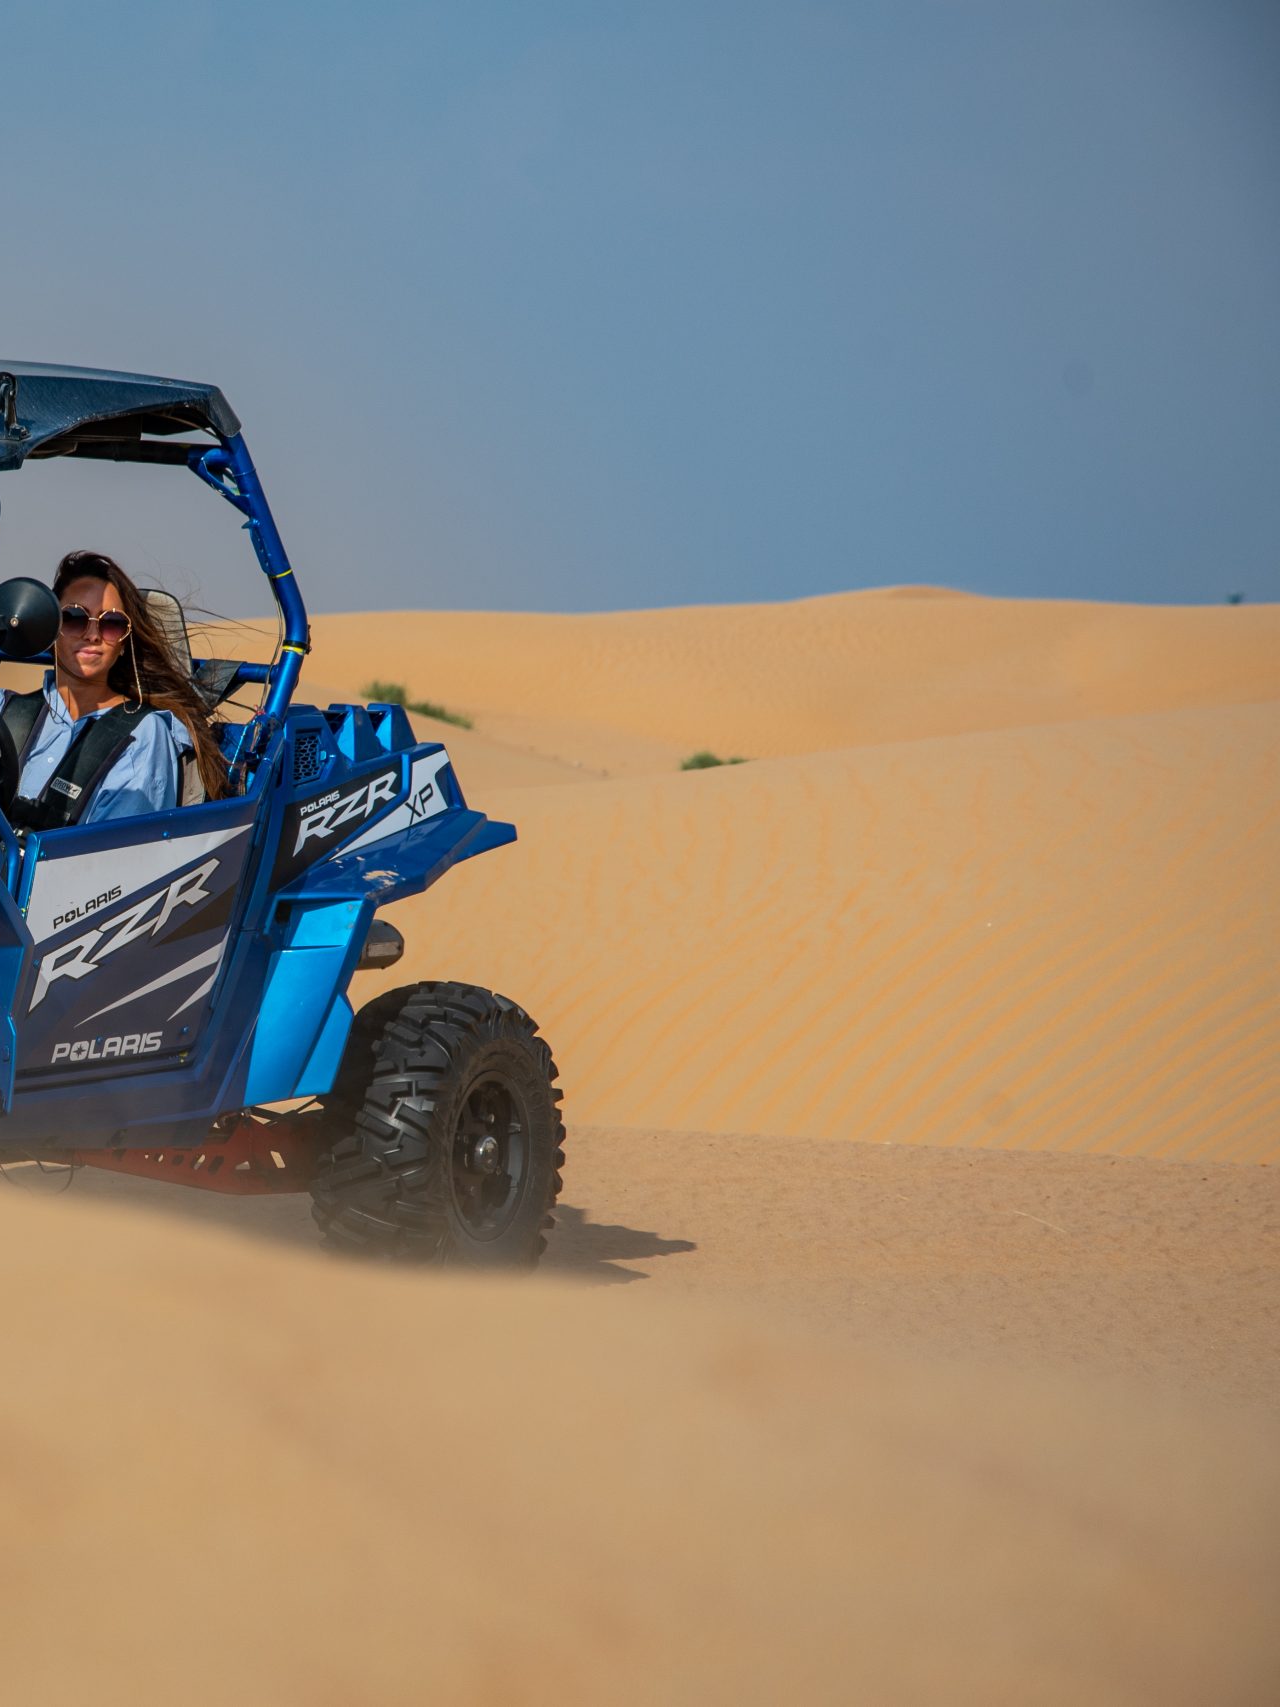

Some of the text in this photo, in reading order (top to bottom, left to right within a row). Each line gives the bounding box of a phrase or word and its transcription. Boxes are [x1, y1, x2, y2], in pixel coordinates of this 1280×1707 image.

[292, 771, 434, 857] RZR XP
[300, 790, 340, 816] POLARIS
[53, 885, 122, 930] POLARIS
[28, 858, 220, 1012] RZR
[51, 1031, 163, 1064] POLARIS
